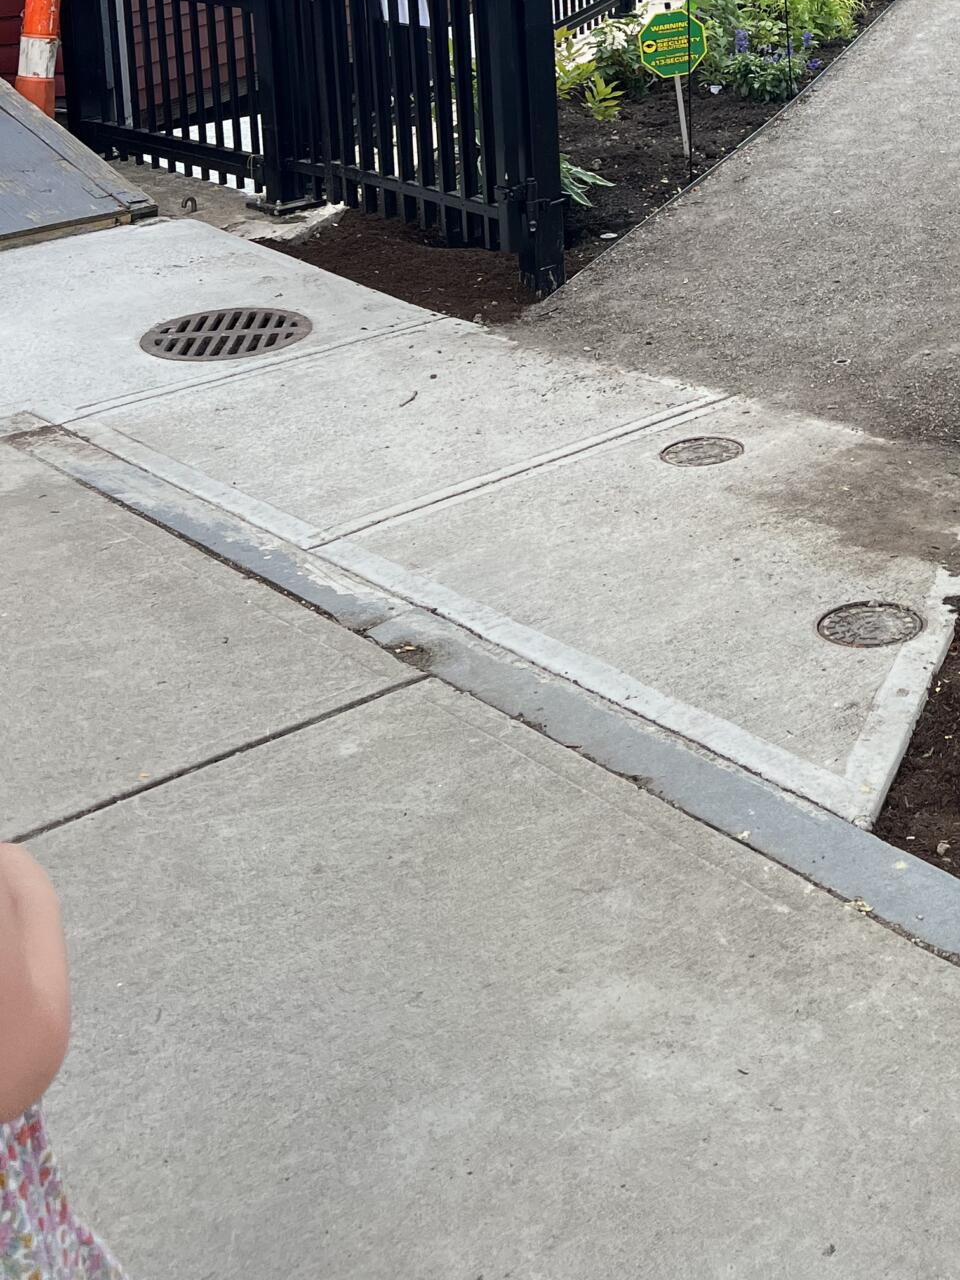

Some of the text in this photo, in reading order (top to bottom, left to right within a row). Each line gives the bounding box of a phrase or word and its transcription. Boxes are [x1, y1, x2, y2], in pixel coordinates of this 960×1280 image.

[650, 21, 688, 31] WARNING
[657, 37, 700, 47] SECURTY
[651, 55, 699, 66] 413-SECURTY
